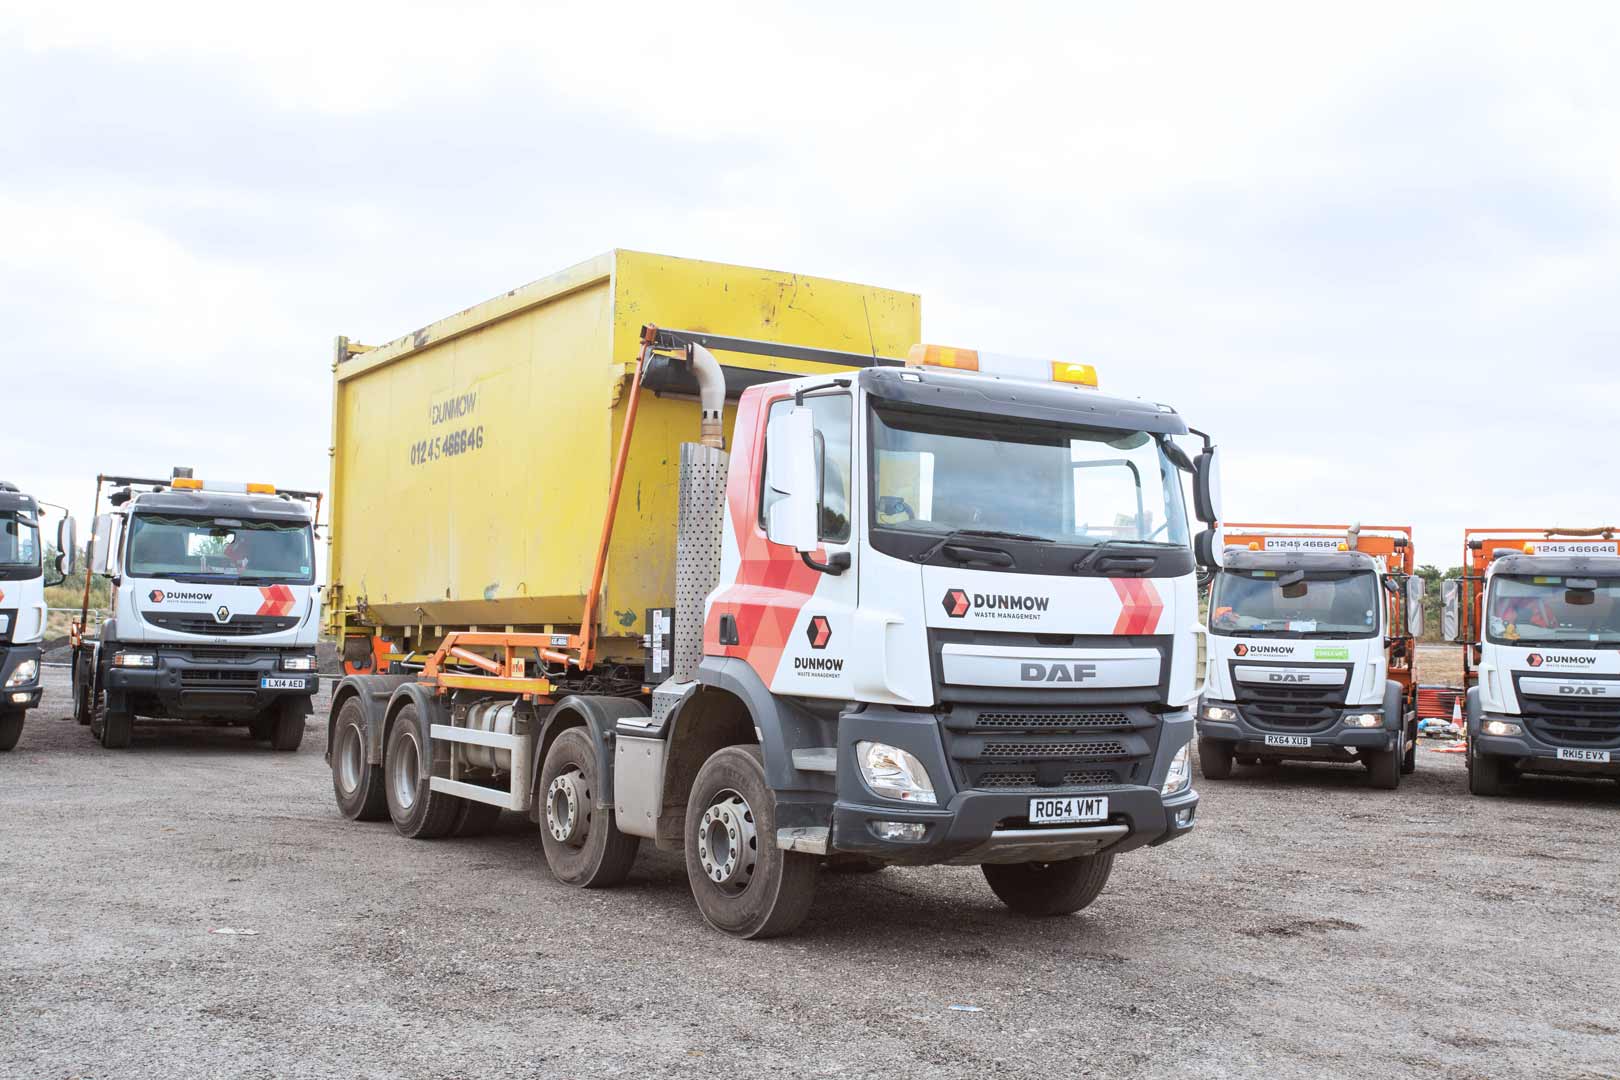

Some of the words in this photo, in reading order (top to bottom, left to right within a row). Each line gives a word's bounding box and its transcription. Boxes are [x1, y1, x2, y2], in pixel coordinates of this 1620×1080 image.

[432, 391, 476, 425] DUNMOW
[1534, 545, 1566, 553] 1245
[1567, 545, 1616, 553] 466646
[166, 592, 212, 600] DUNMOW
[974, 593, 1050, 611] DUNMOW
[997, 612, 1041, 621] MANAGEMENT
[1250, 645, 1295, 654] DUNMOW
[794, 657, 844, 671] DUNMOW
[1545, 655, 1597, 665] DUNMOW
[1020, 663, 1097, 682] DAF
[1268, 673, 1311, 683] DAF
[268, 680, 287, 688] LX14
[288, 680, 303, 688] AED
[1559, 685, 1606, 696] DAF
[1268, 735, 1290, 744] RX64
[1291, 737, 1308, 745] XUB
[1562, 749, 1584, 759] RK15
[1585, 751, 1605, 761] EVX
[1035, 801, 1073, 818] RO64
[1076, 799, 1103, 816] VMT
